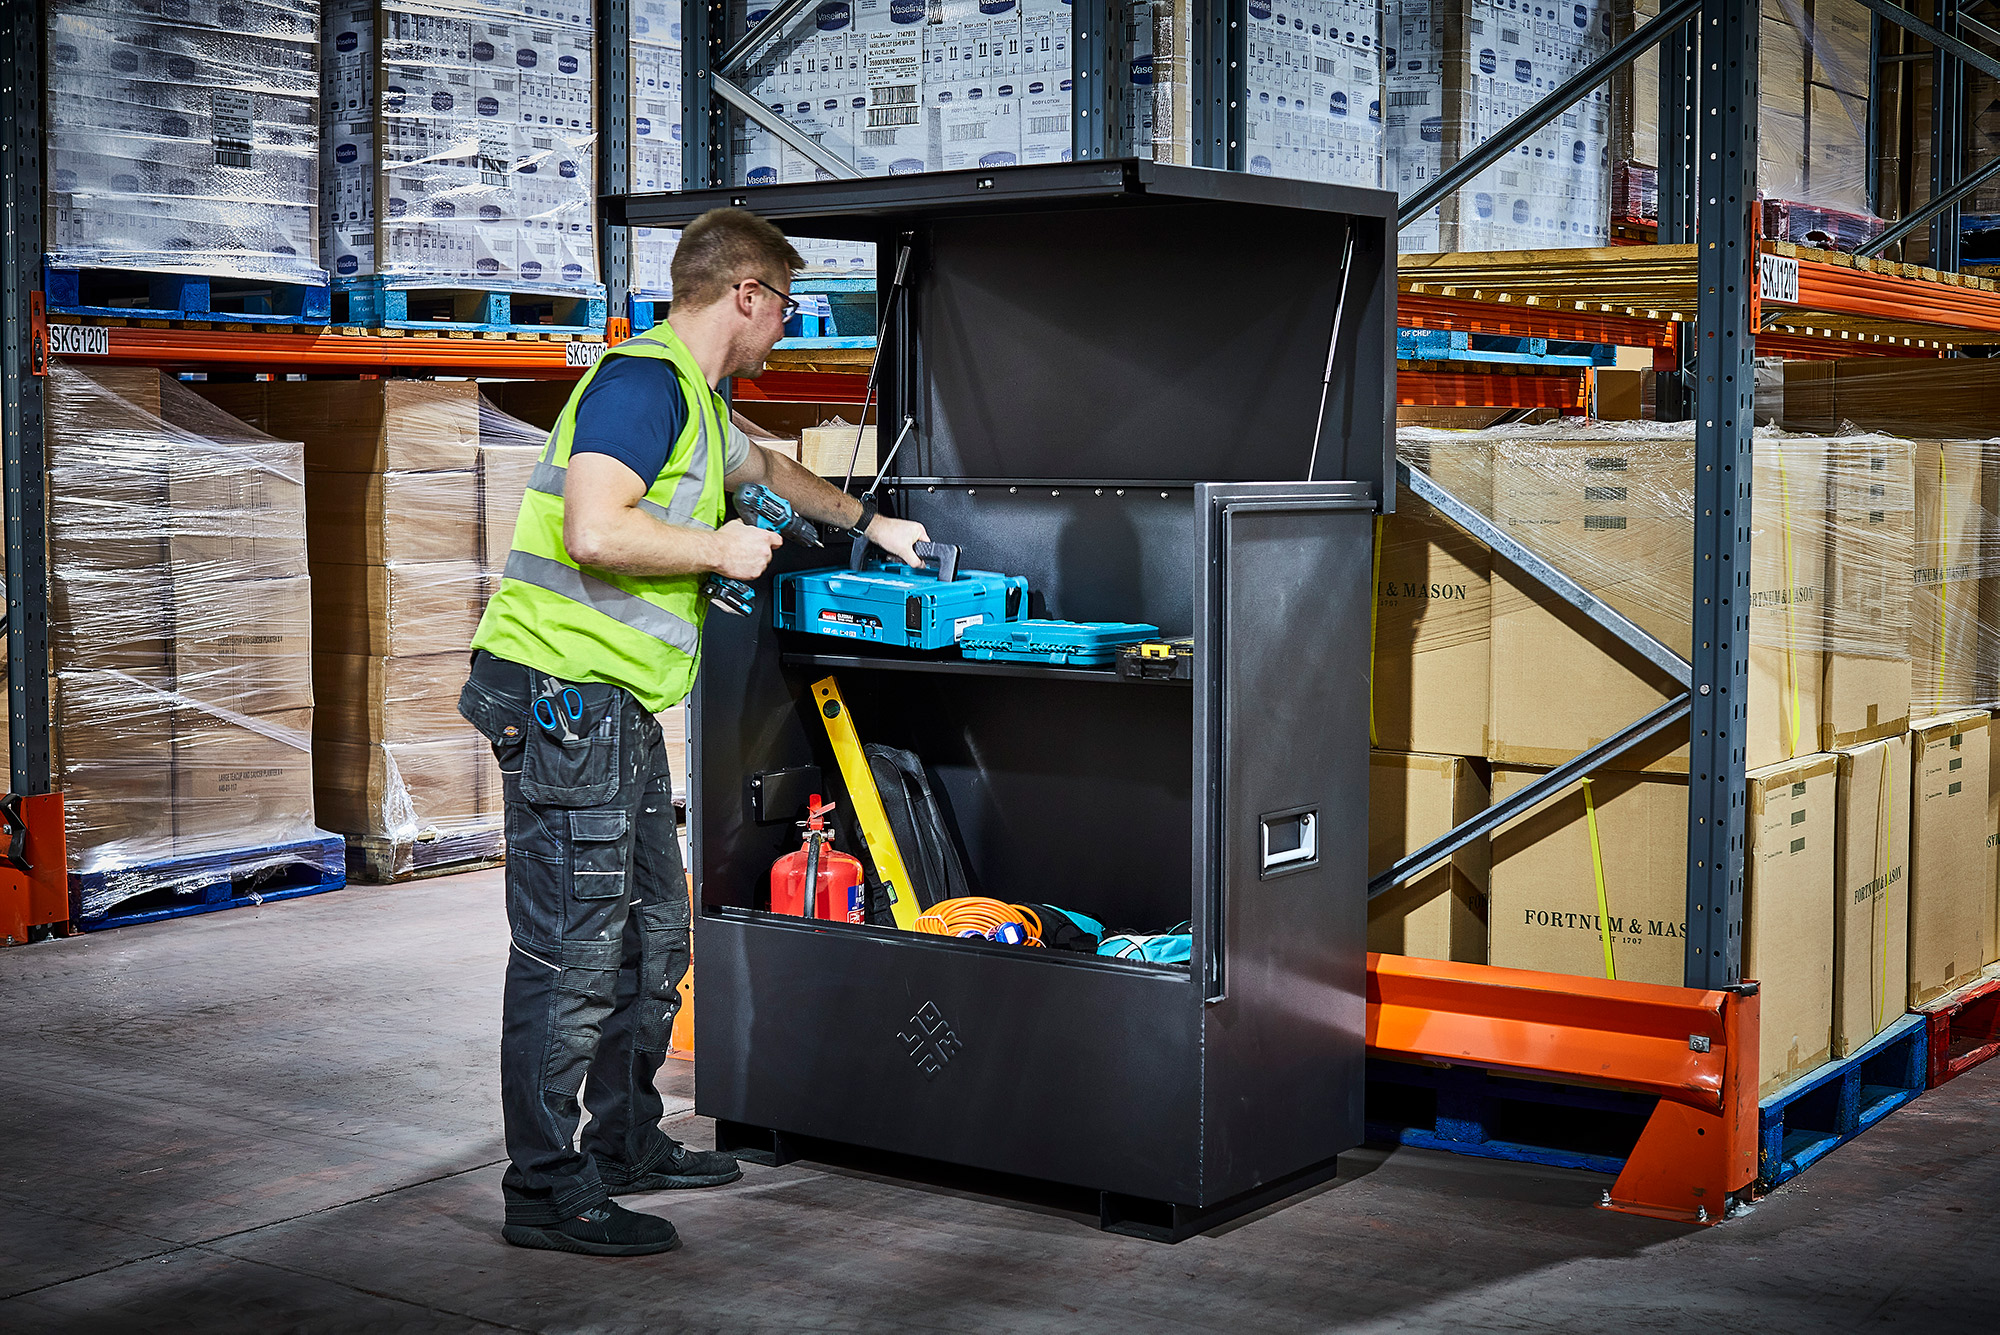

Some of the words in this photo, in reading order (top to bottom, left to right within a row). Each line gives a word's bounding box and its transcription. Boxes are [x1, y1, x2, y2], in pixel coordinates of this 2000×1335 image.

[818, 11, 850, 21] Vaseline
[1131, 65, 1153, 74] Vase
[748, 175, 776, 184] Vaseline
[1762, 256, 1797, 300] SKJ1201
[51, 325, 107, 353] SKG1201
[1386, 581, 1399, 597] &
[1402, 582, 1467, 600] MASON
[1524, 909, 1624, 933] FORTNUM
[1628, 918, 1643, 934] &
[1647, 919, 1687, 939] MAS
[1598, 935, 1616, 943] ET
[1622, 937, 1642, 945] 1707
